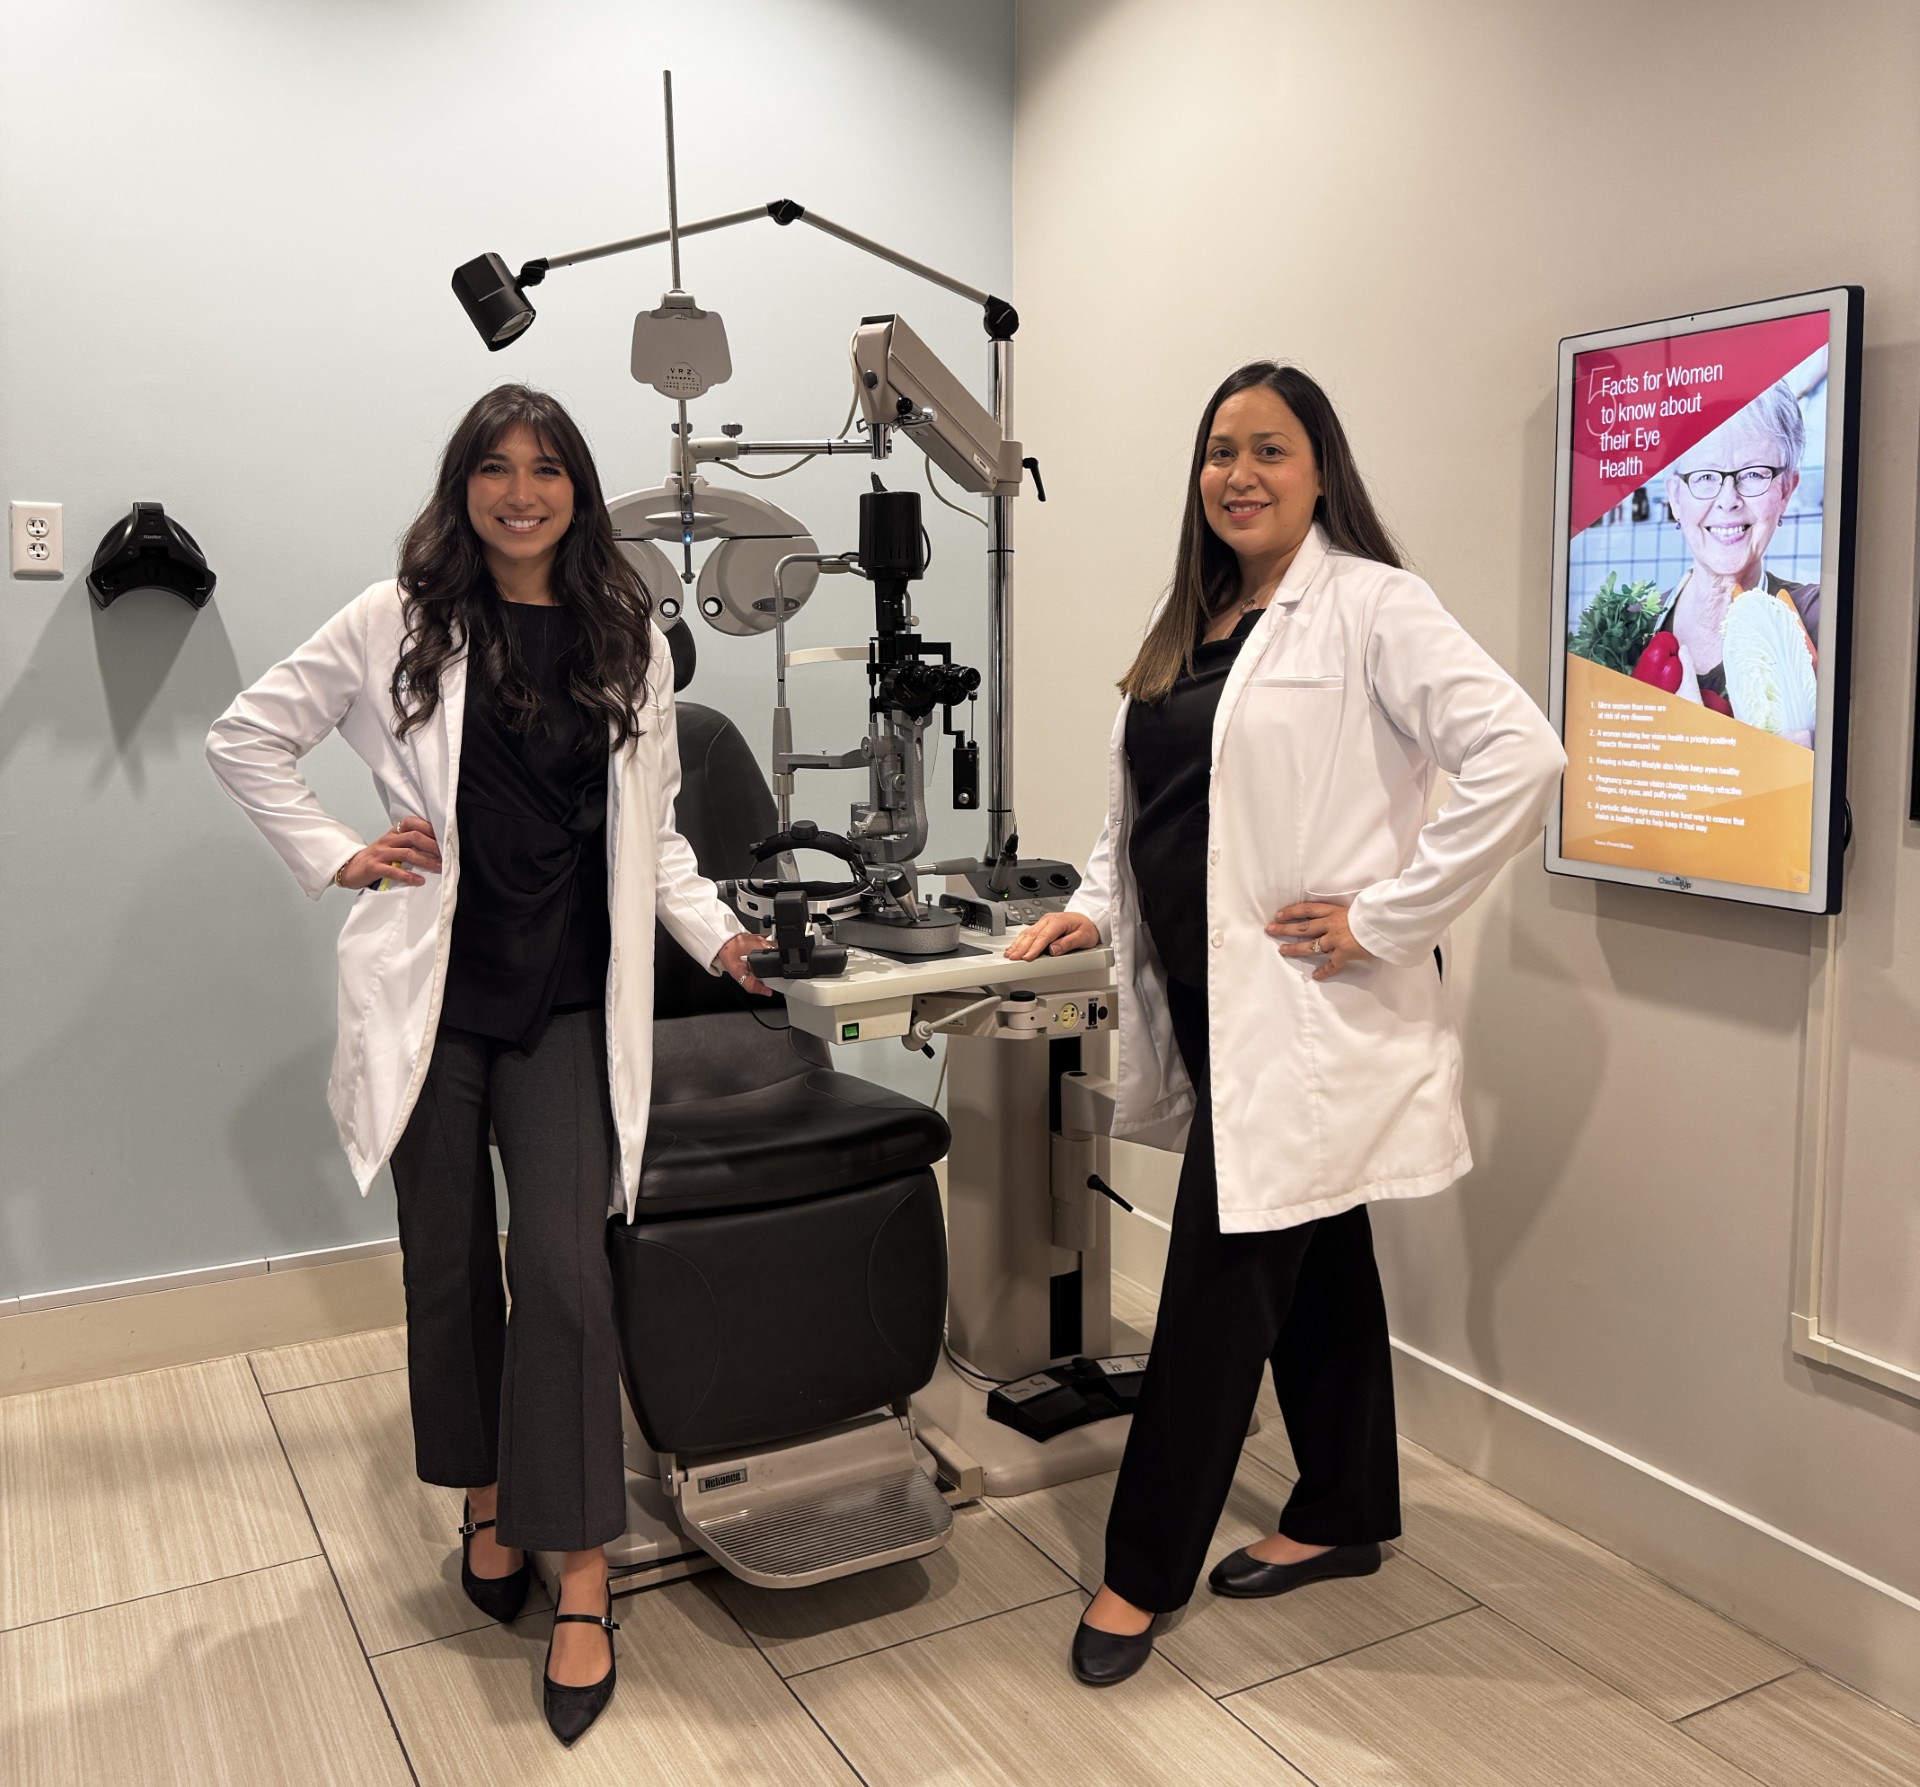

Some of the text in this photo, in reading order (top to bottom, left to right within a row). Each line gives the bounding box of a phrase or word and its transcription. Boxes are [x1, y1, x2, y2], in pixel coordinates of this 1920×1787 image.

[1602, 364, 1723, 397] Facts for Women
[1586, 365, 1617, 437] 5
[1601, 392, 1702, 424] to know about
[1600, 427, 1660, 452] their Eye
[1600, 456, 1643, 479] Health
